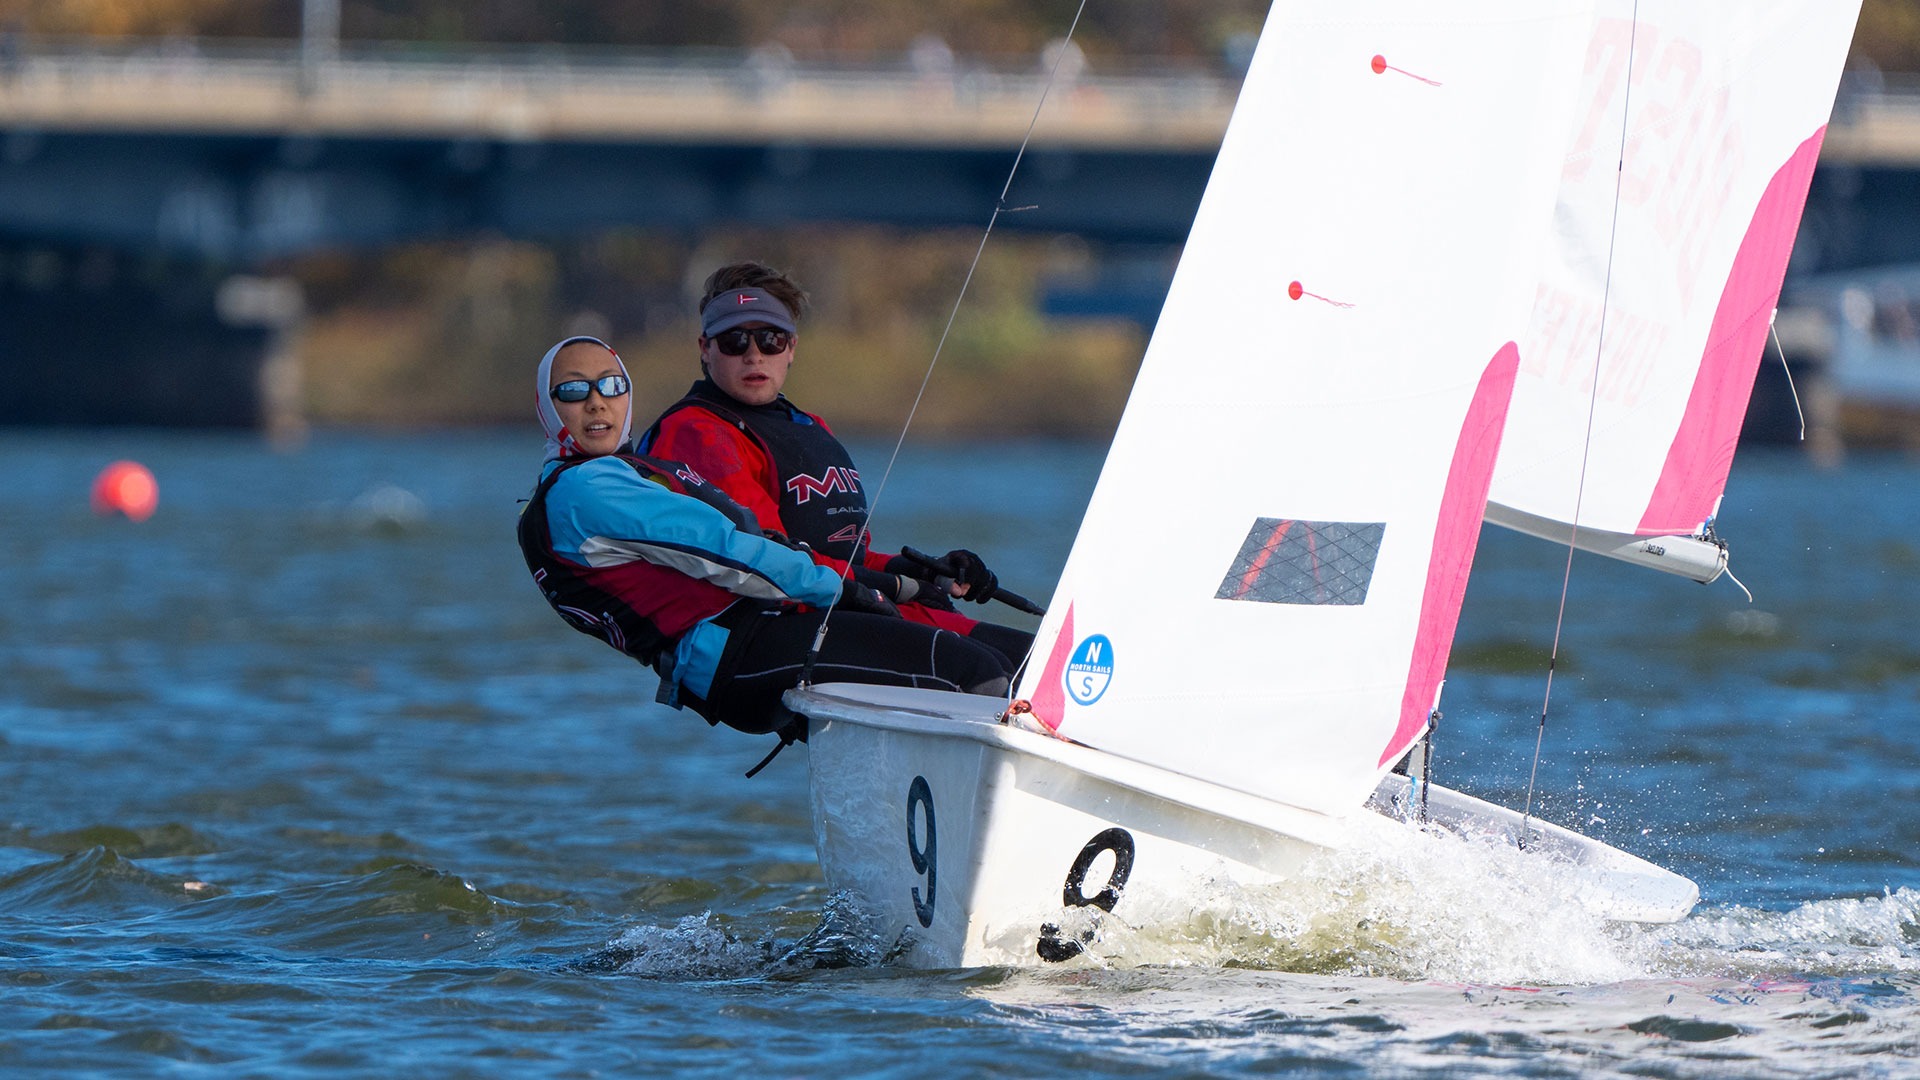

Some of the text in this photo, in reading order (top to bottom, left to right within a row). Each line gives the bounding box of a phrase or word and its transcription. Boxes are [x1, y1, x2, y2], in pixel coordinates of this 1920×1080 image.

[1085, 641, 1103, 664] N
[1069, 663, 1111, 674] NORTH SAILS
[1081, 676, 1094, 698] S
[906, 775, 938, 929] 9
